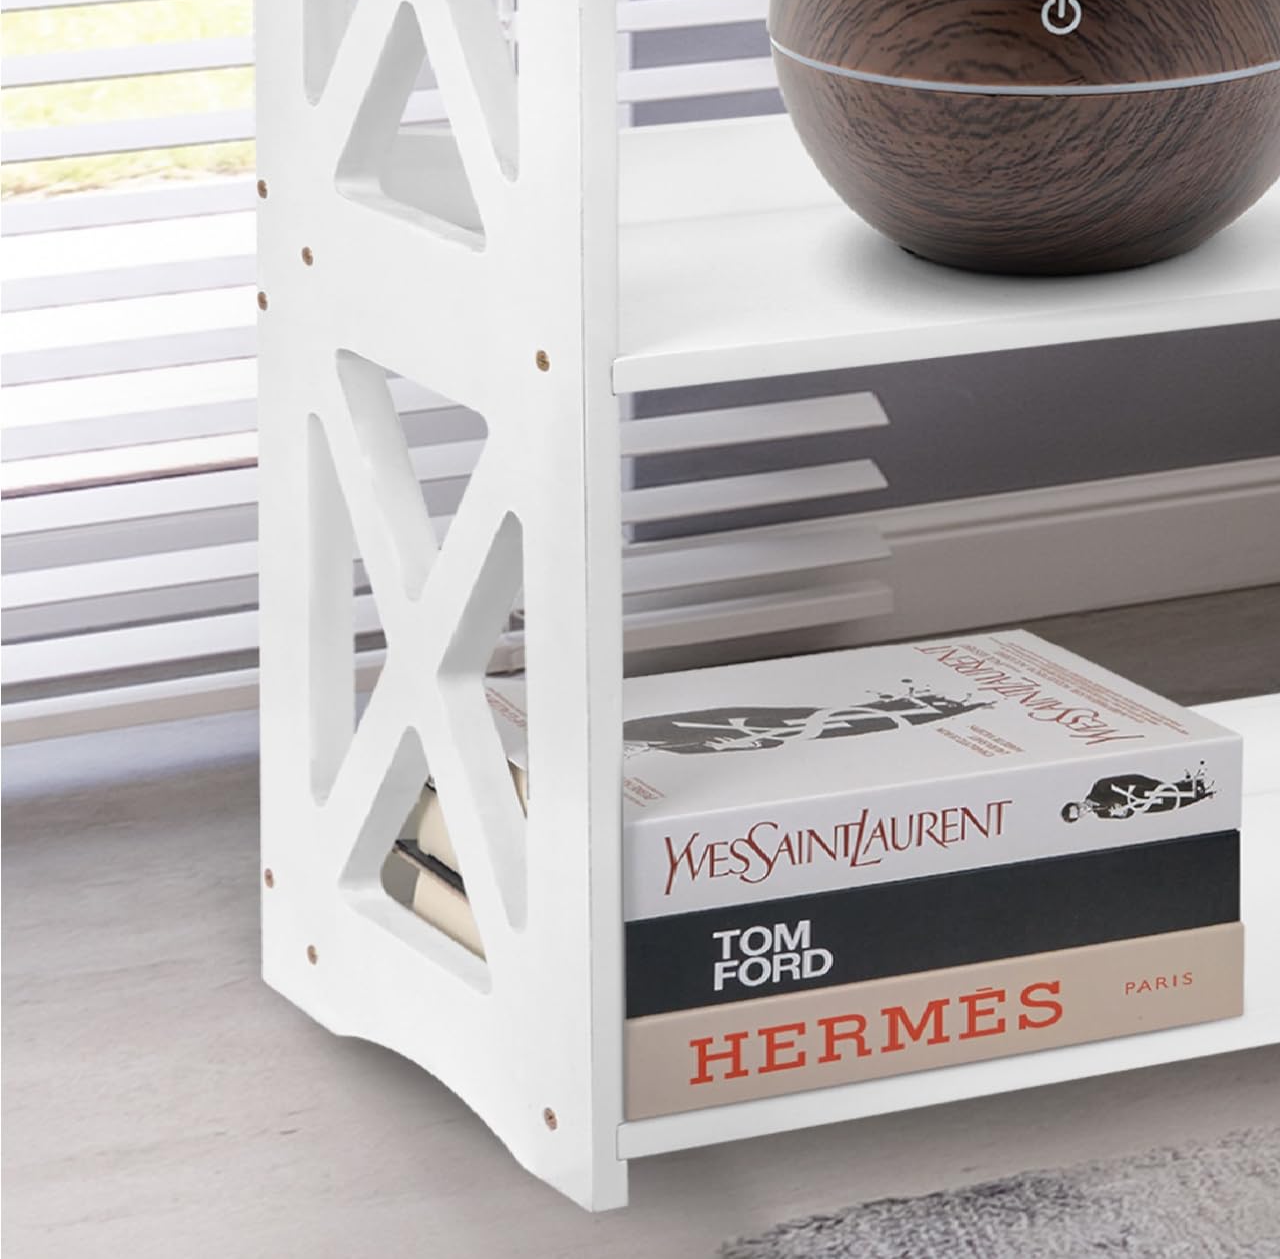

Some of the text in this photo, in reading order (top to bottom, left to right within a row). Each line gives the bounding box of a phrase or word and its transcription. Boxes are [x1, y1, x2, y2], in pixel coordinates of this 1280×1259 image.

[712, 920, 812, 961] TOM
[713, 948, 834, 992] FORD
[1125, 972, 1194, 996] PARIS
